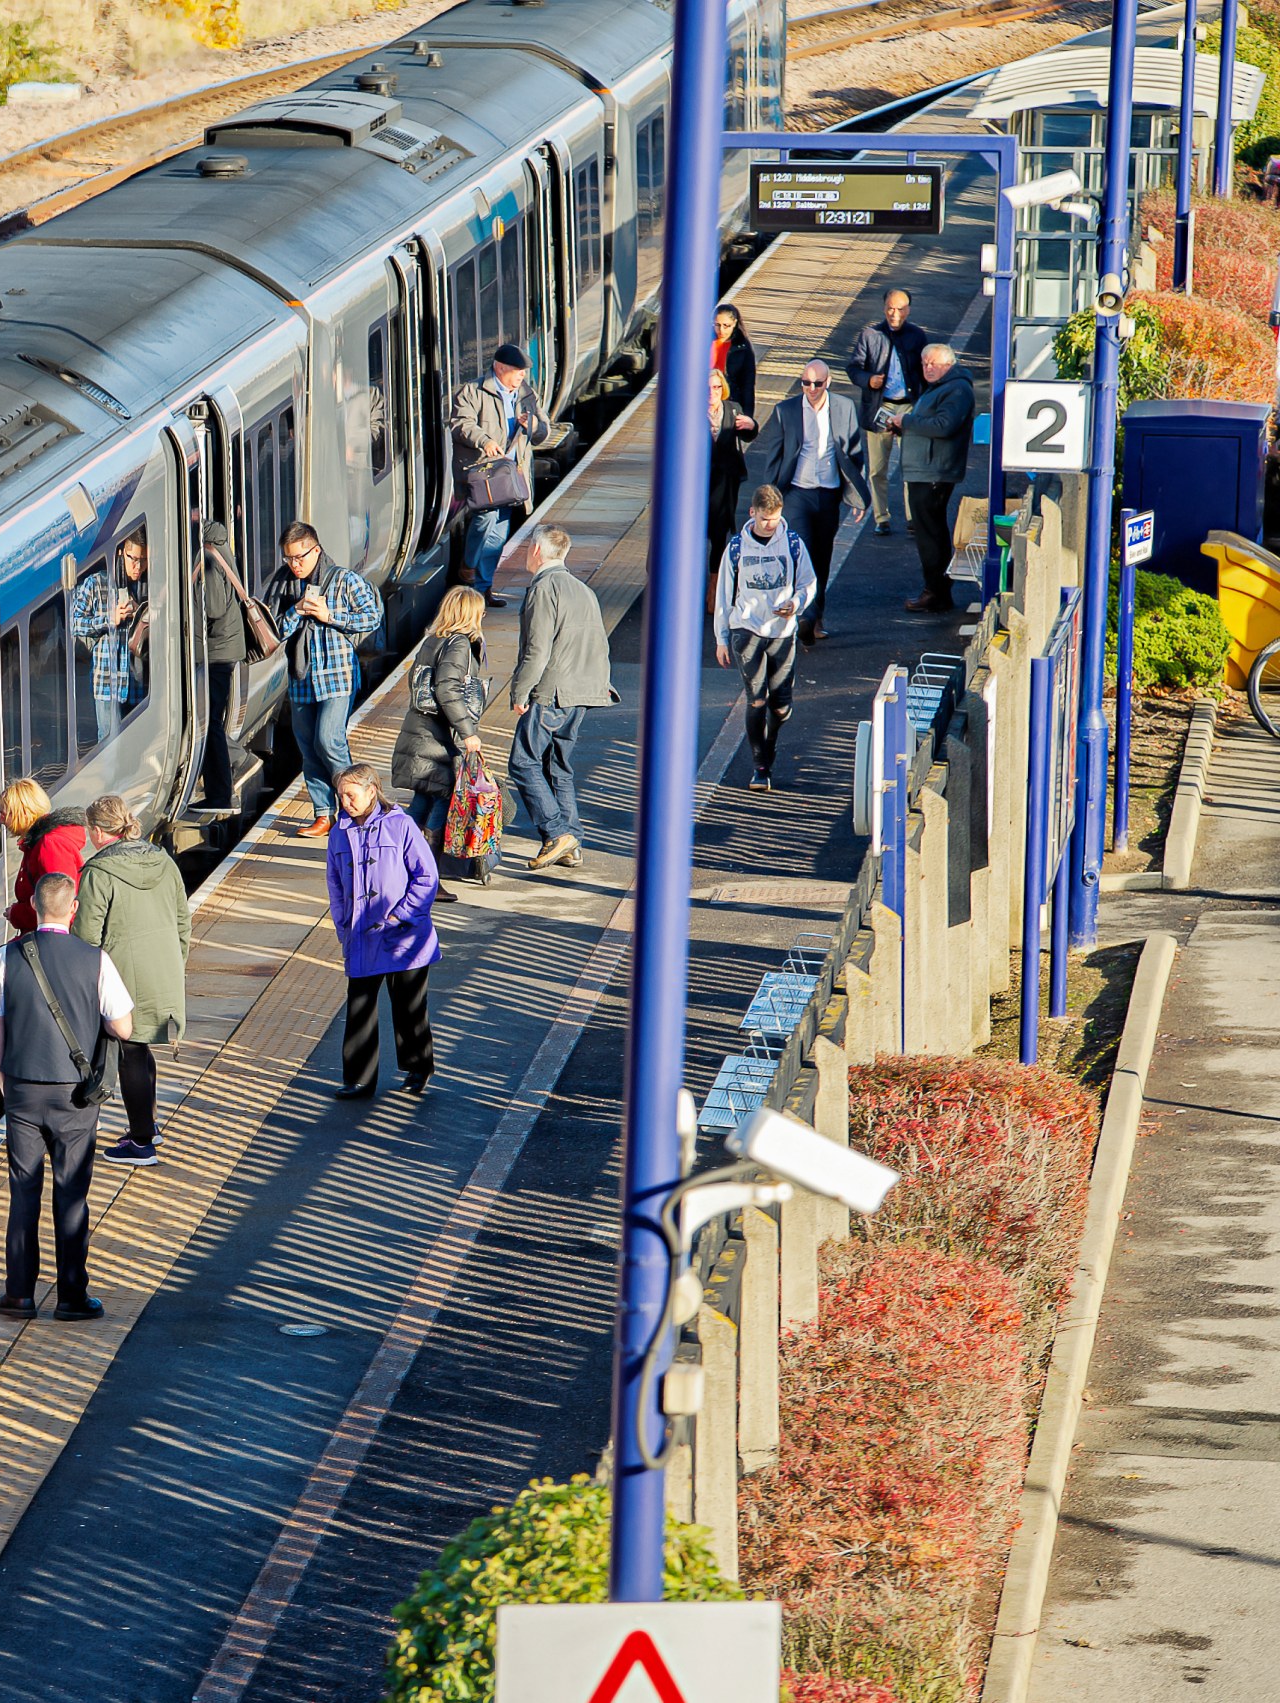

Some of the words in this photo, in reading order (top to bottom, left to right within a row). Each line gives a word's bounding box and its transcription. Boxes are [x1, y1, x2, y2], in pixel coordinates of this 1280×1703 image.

[795, 173, 845, 184] Middlesbrough
[905, 174, 915, 183] On
[818, 211, 871, 224] 12:31:21
[1026, 399, 1068, 454] 2
